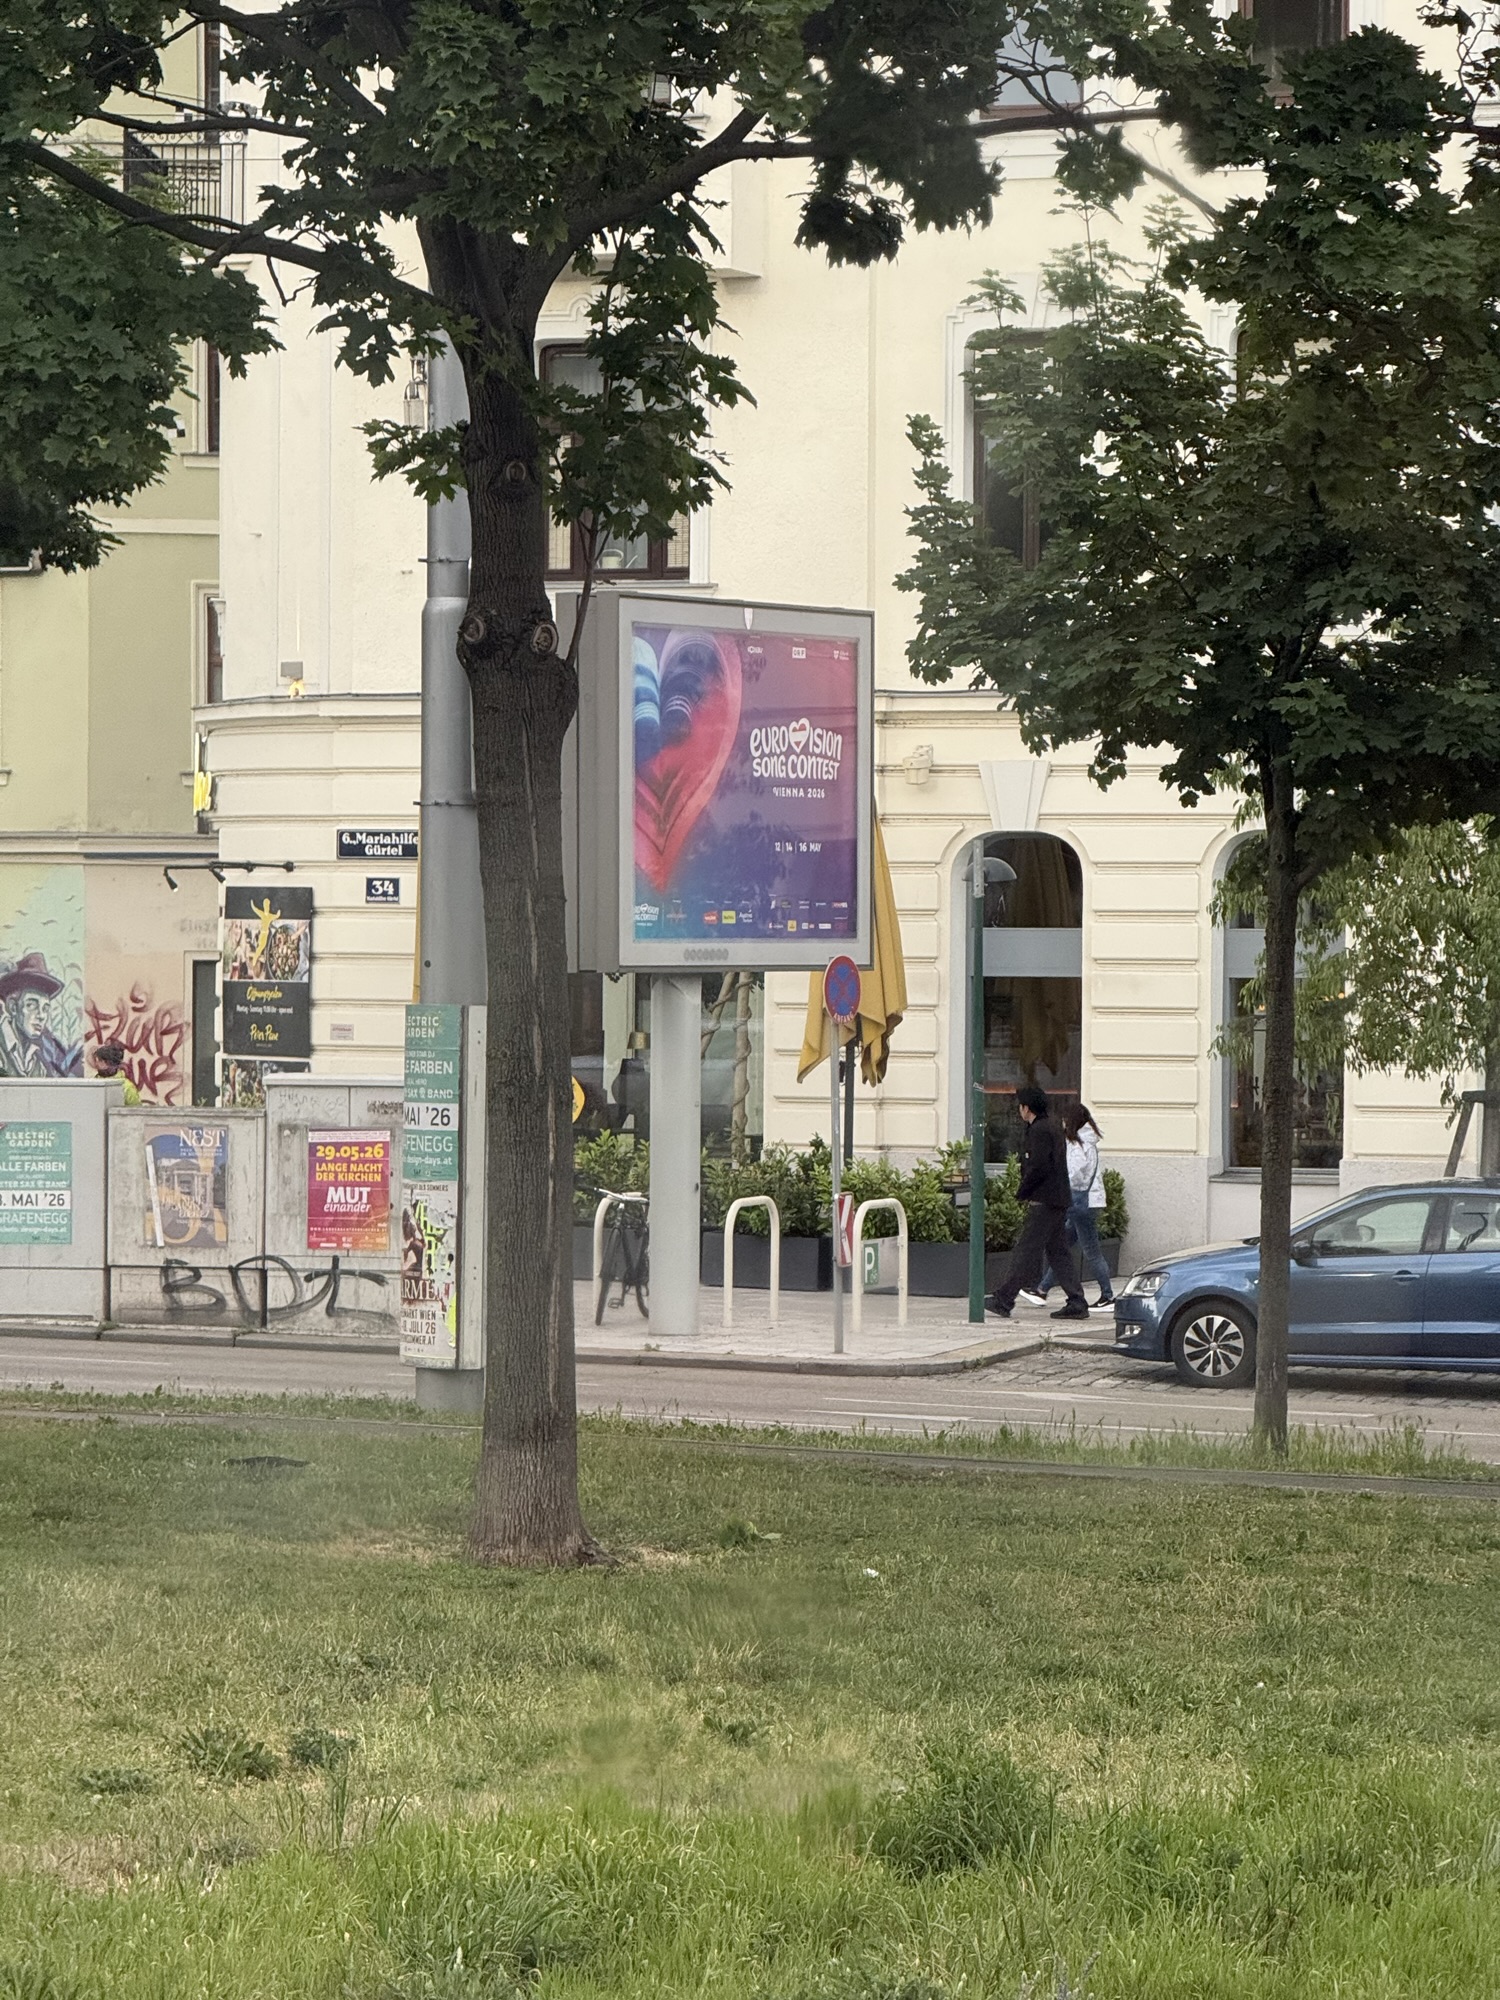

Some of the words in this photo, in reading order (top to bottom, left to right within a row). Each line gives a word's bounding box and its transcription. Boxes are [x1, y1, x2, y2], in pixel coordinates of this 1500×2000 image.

[752, 755, 786, 778] SONG
[788, 755, 839, 780] CONTEST
[773, 787, 804, 797] VIENNA
[808, 788, 825, 798] 2026
[356, 832, 418, 844] Mariahilfe
[365, 844, 402, 855] Gürtel
[775, 842, 781, 851] 12
[786, 843, 793, 851] 14
[799, 843, 807, 852] 16
[810, 843, 822, 852] MAY
[371, 880, 394, 895] 34
[406, 1015, 439, 1027] ECTRIC
[407, 1028, 435, 1037] ARDEN
[410, 1060, 453, 1074] FARBEN
[427, 1089, 453, 1099] BAND
[5, 1131, 55, 1140] ELECTRIC
[179, 1129, 225, 1147] NEST
[406, 1134, 453, 1152] FENEGG
[316, 1143, 384, 1160] 29.05.26
[0, 1162, 22, 1172] LLE
[25, 1162, 66, 1172] FARBEN
[316, 1163, 347, 1171] LANGE
[350, 1163, 382, 1172] NACHT
[316, 1173, 335, 1181] DER
[338, 1173, 381, 1182] KIRCHEN
[12, 1193, 39, 1206] MAI
[326, 1186, 371, 1203] MUT
[323, 1201, 371, 1213] einander
[864, 1247, 875, 1283] P
[402, 1279, 438, 1300] RME
[419, 1309, 436, 1320] WIEN
[409, 1322, 423, 1334] JULI
[425, 1323, 436, 1334] 26
